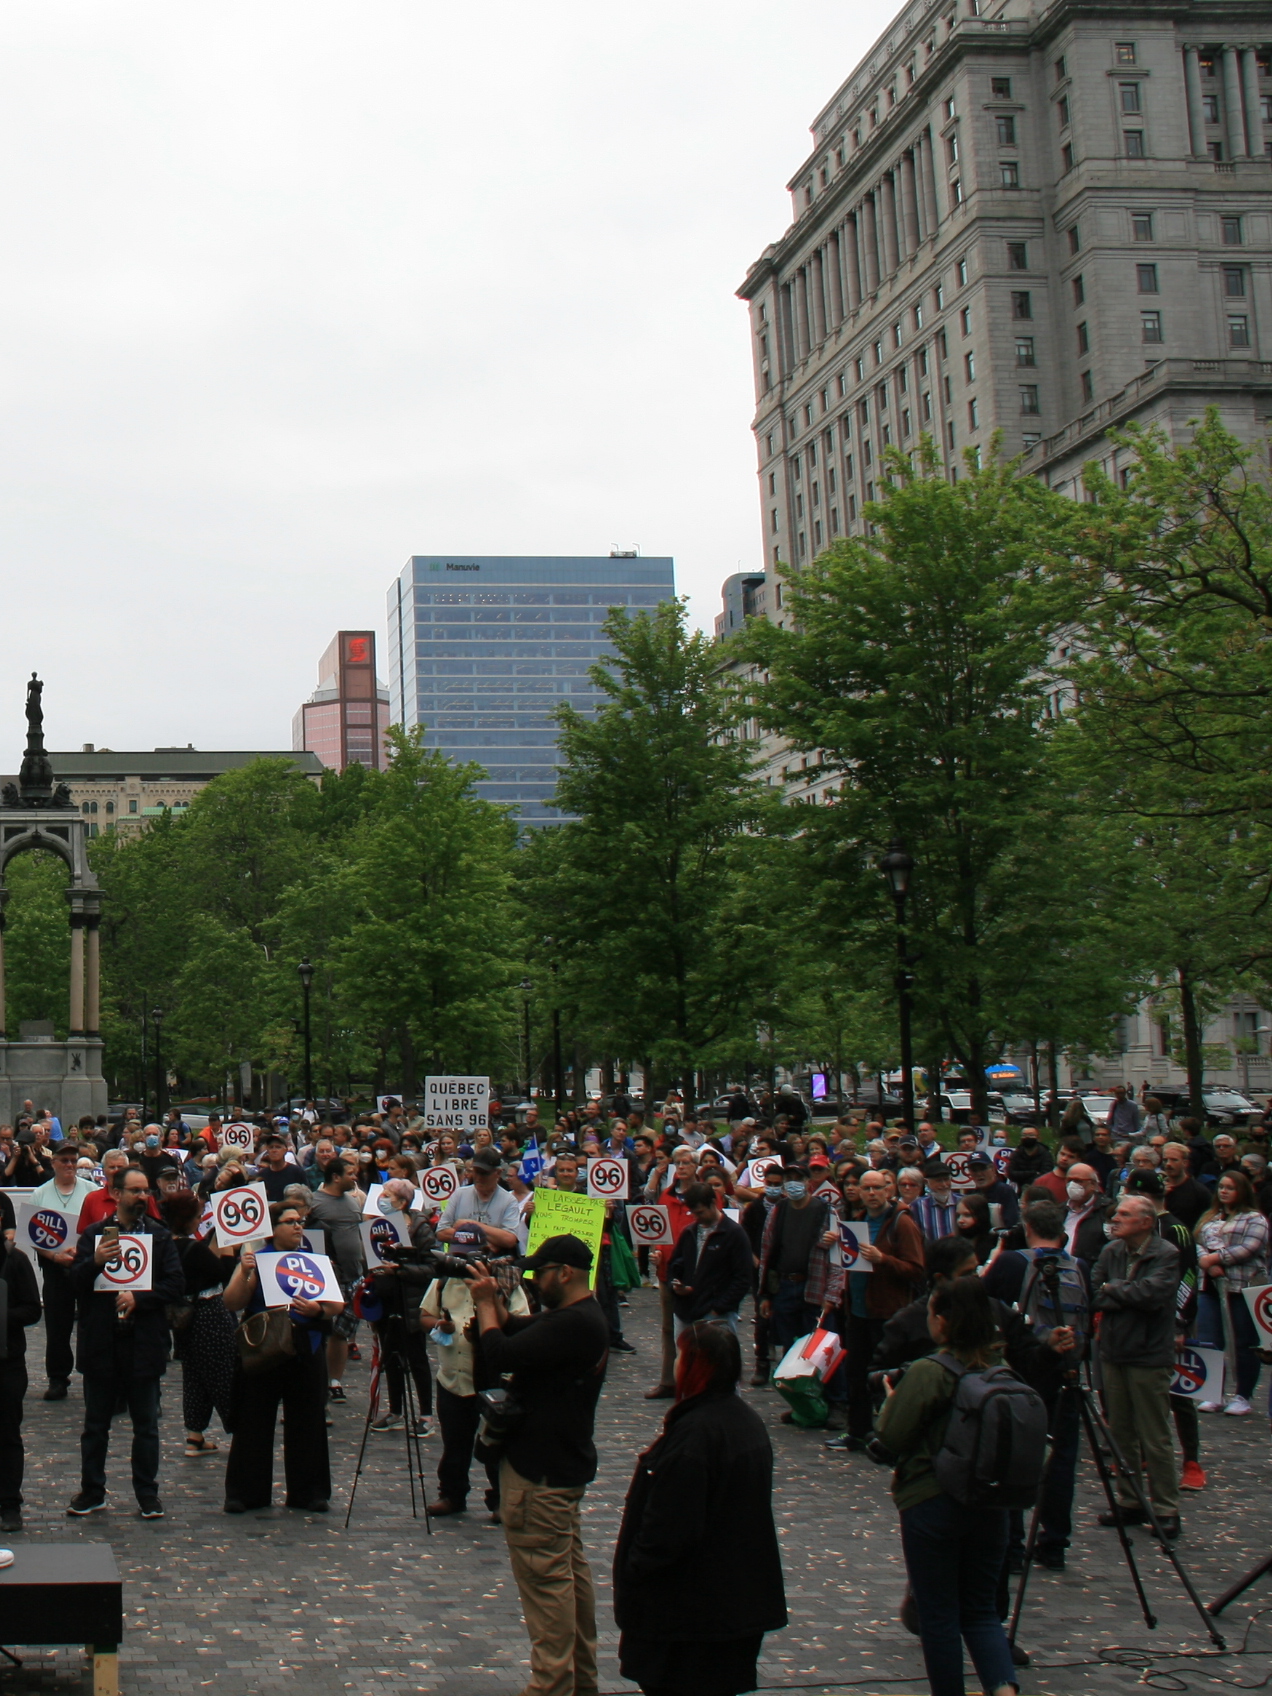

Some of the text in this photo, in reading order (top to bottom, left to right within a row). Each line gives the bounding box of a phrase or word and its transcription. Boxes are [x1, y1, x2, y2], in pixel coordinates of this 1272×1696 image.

[446, 563, 480, 572] Manuvie
[434, 1099, 479, 1110] LIBRE
[427, 1114, 486, 1126] SANS 96
[229, 1130, 247, 1144] 96
[427, 1174, 452, 1195] 96
[596, 1168, 620, 1185] 96
[536, 1190, 548, 1200] NE
[224, 1198, 259, 1227] 96
[547, 1202, 594, 1216] LEGAULT
[37, 1212, 63, 1230] BILL
[636, 1214, 662, 1232] 96
[35, 1227, 59, 1248] 96
[106, 1248, 140, 1273] 96
[286, 1257, 312, 1273] PL
[287, 1273, 321, 1297] 96
[1175, 1353, 1200, 1368] ILL
